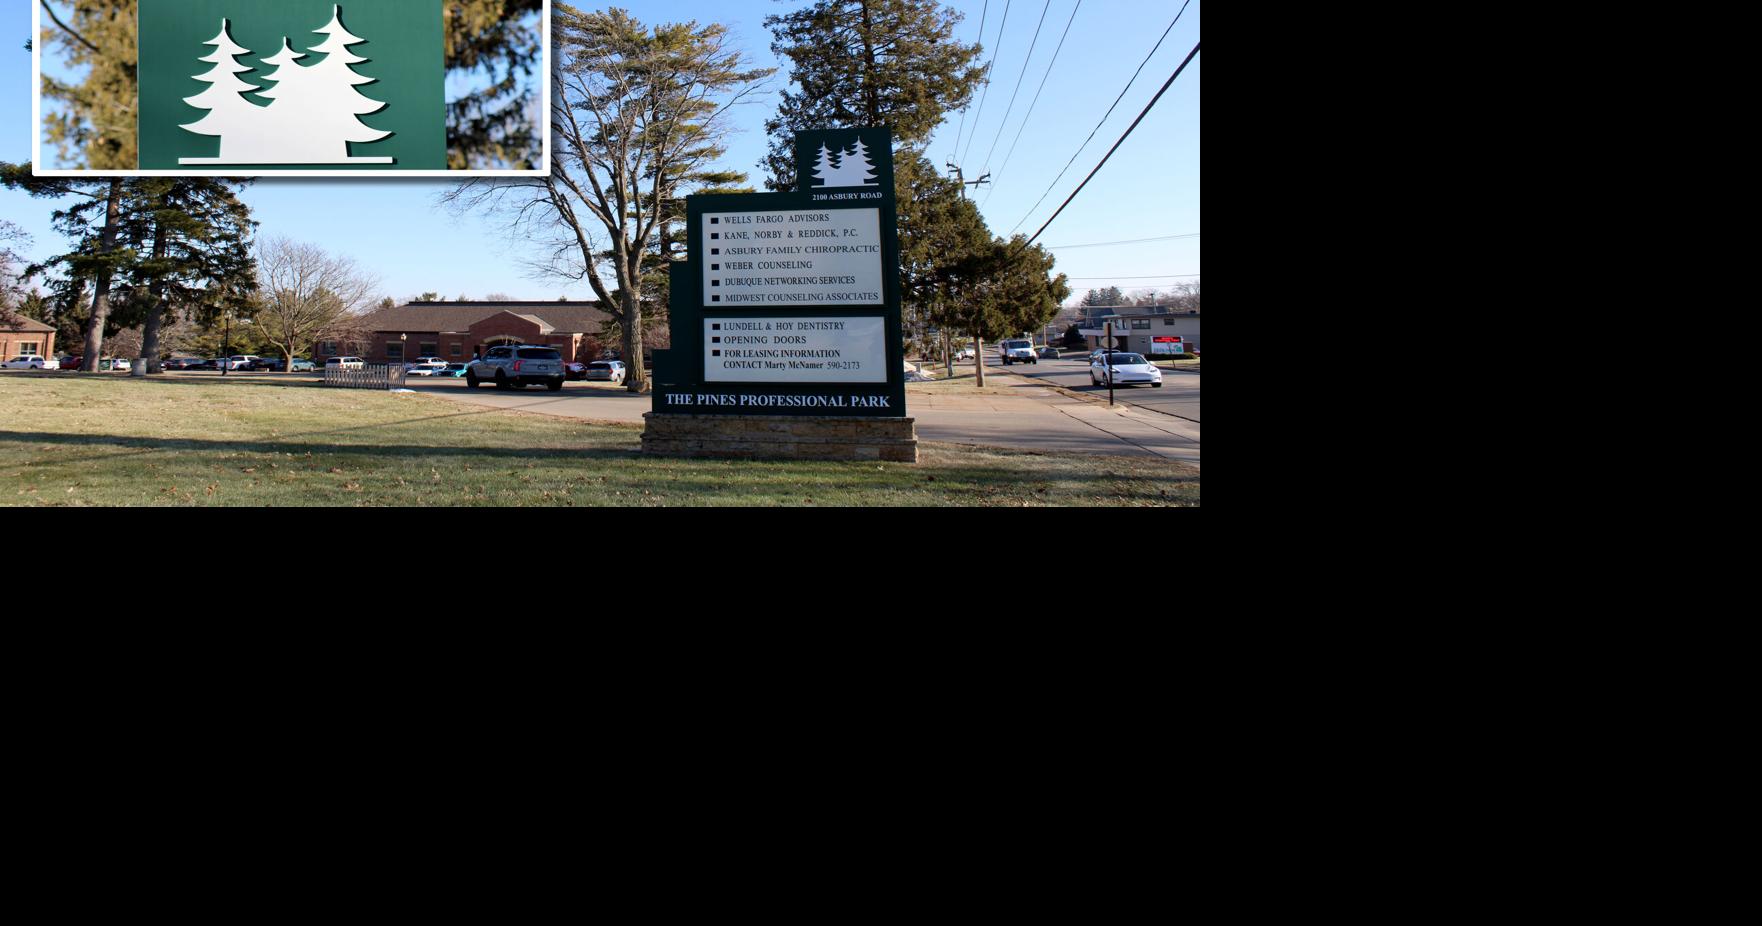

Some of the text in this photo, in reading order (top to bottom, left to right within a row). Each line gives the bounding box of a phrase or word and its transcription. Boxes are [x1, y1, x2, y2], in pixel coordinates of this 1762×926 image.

[789, 214, 829, 222] ADVISORS
[724, 232, 750, 240] KANE,
[754, 230, 782, 238] NORBY
[799, 229, 839, 238] REDDICK,
[766, 246, 802, 254] FAMILY
[805, 245, 879, 253] CHIROPRACTIC
[758, 261, 812, 269] COUNSELING
[725, 276, 855, 286] DUBUQUE NETWORKING SERVICES
[826, 292, 878, 300] ASSOCIATES
[724, 322, 763, 330] LUNDELL
[798, 322, 845, 330] DENTISTRY
[743, 350, 779, 358] LEASING
[765, 361, 786, 371] Marty
[666, 394, 890, 407] THE PINES PROFESSIONAL PARK
